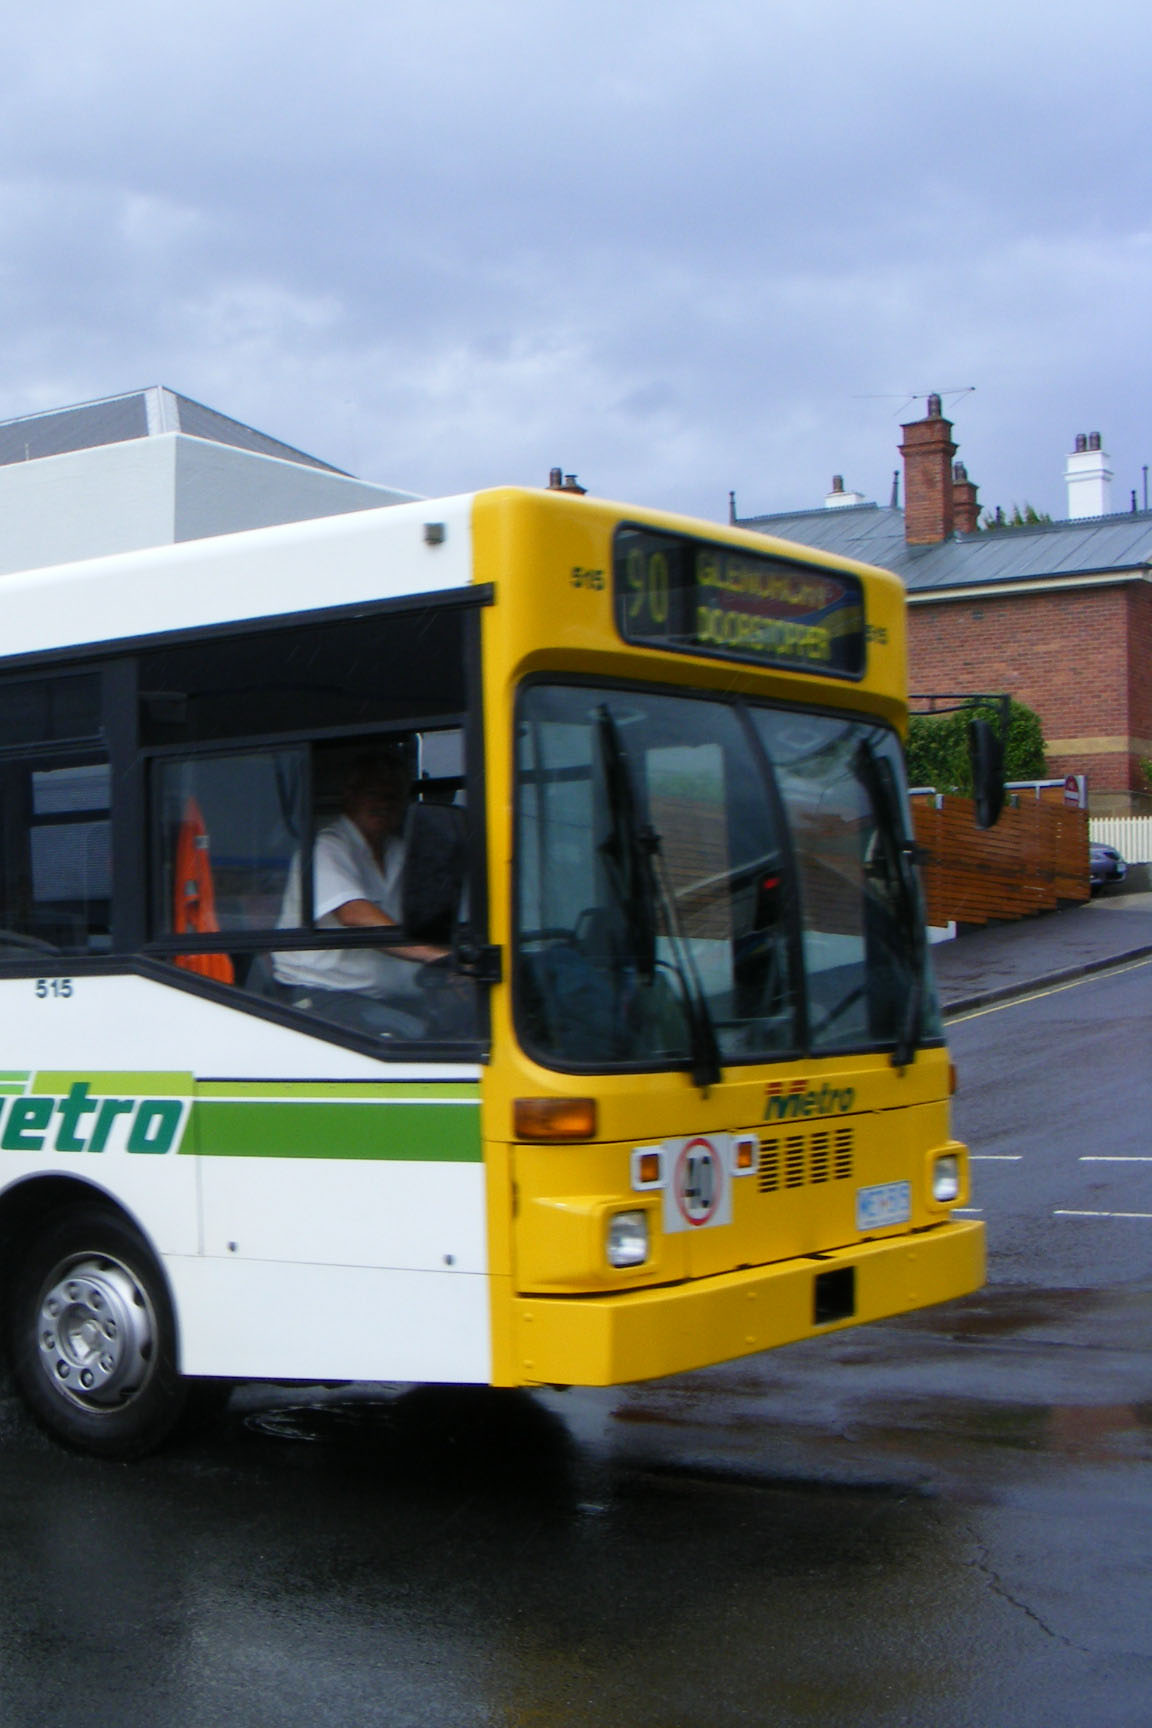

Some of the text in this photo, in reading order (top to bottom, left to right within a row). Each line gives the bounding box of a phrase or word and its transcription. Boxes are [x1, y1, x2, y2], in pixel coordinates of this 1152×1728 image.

[624, 545, 669, 624] 90
[35, 979, 74, 999] 515
[763, 1080, 856, 1122] Metro
